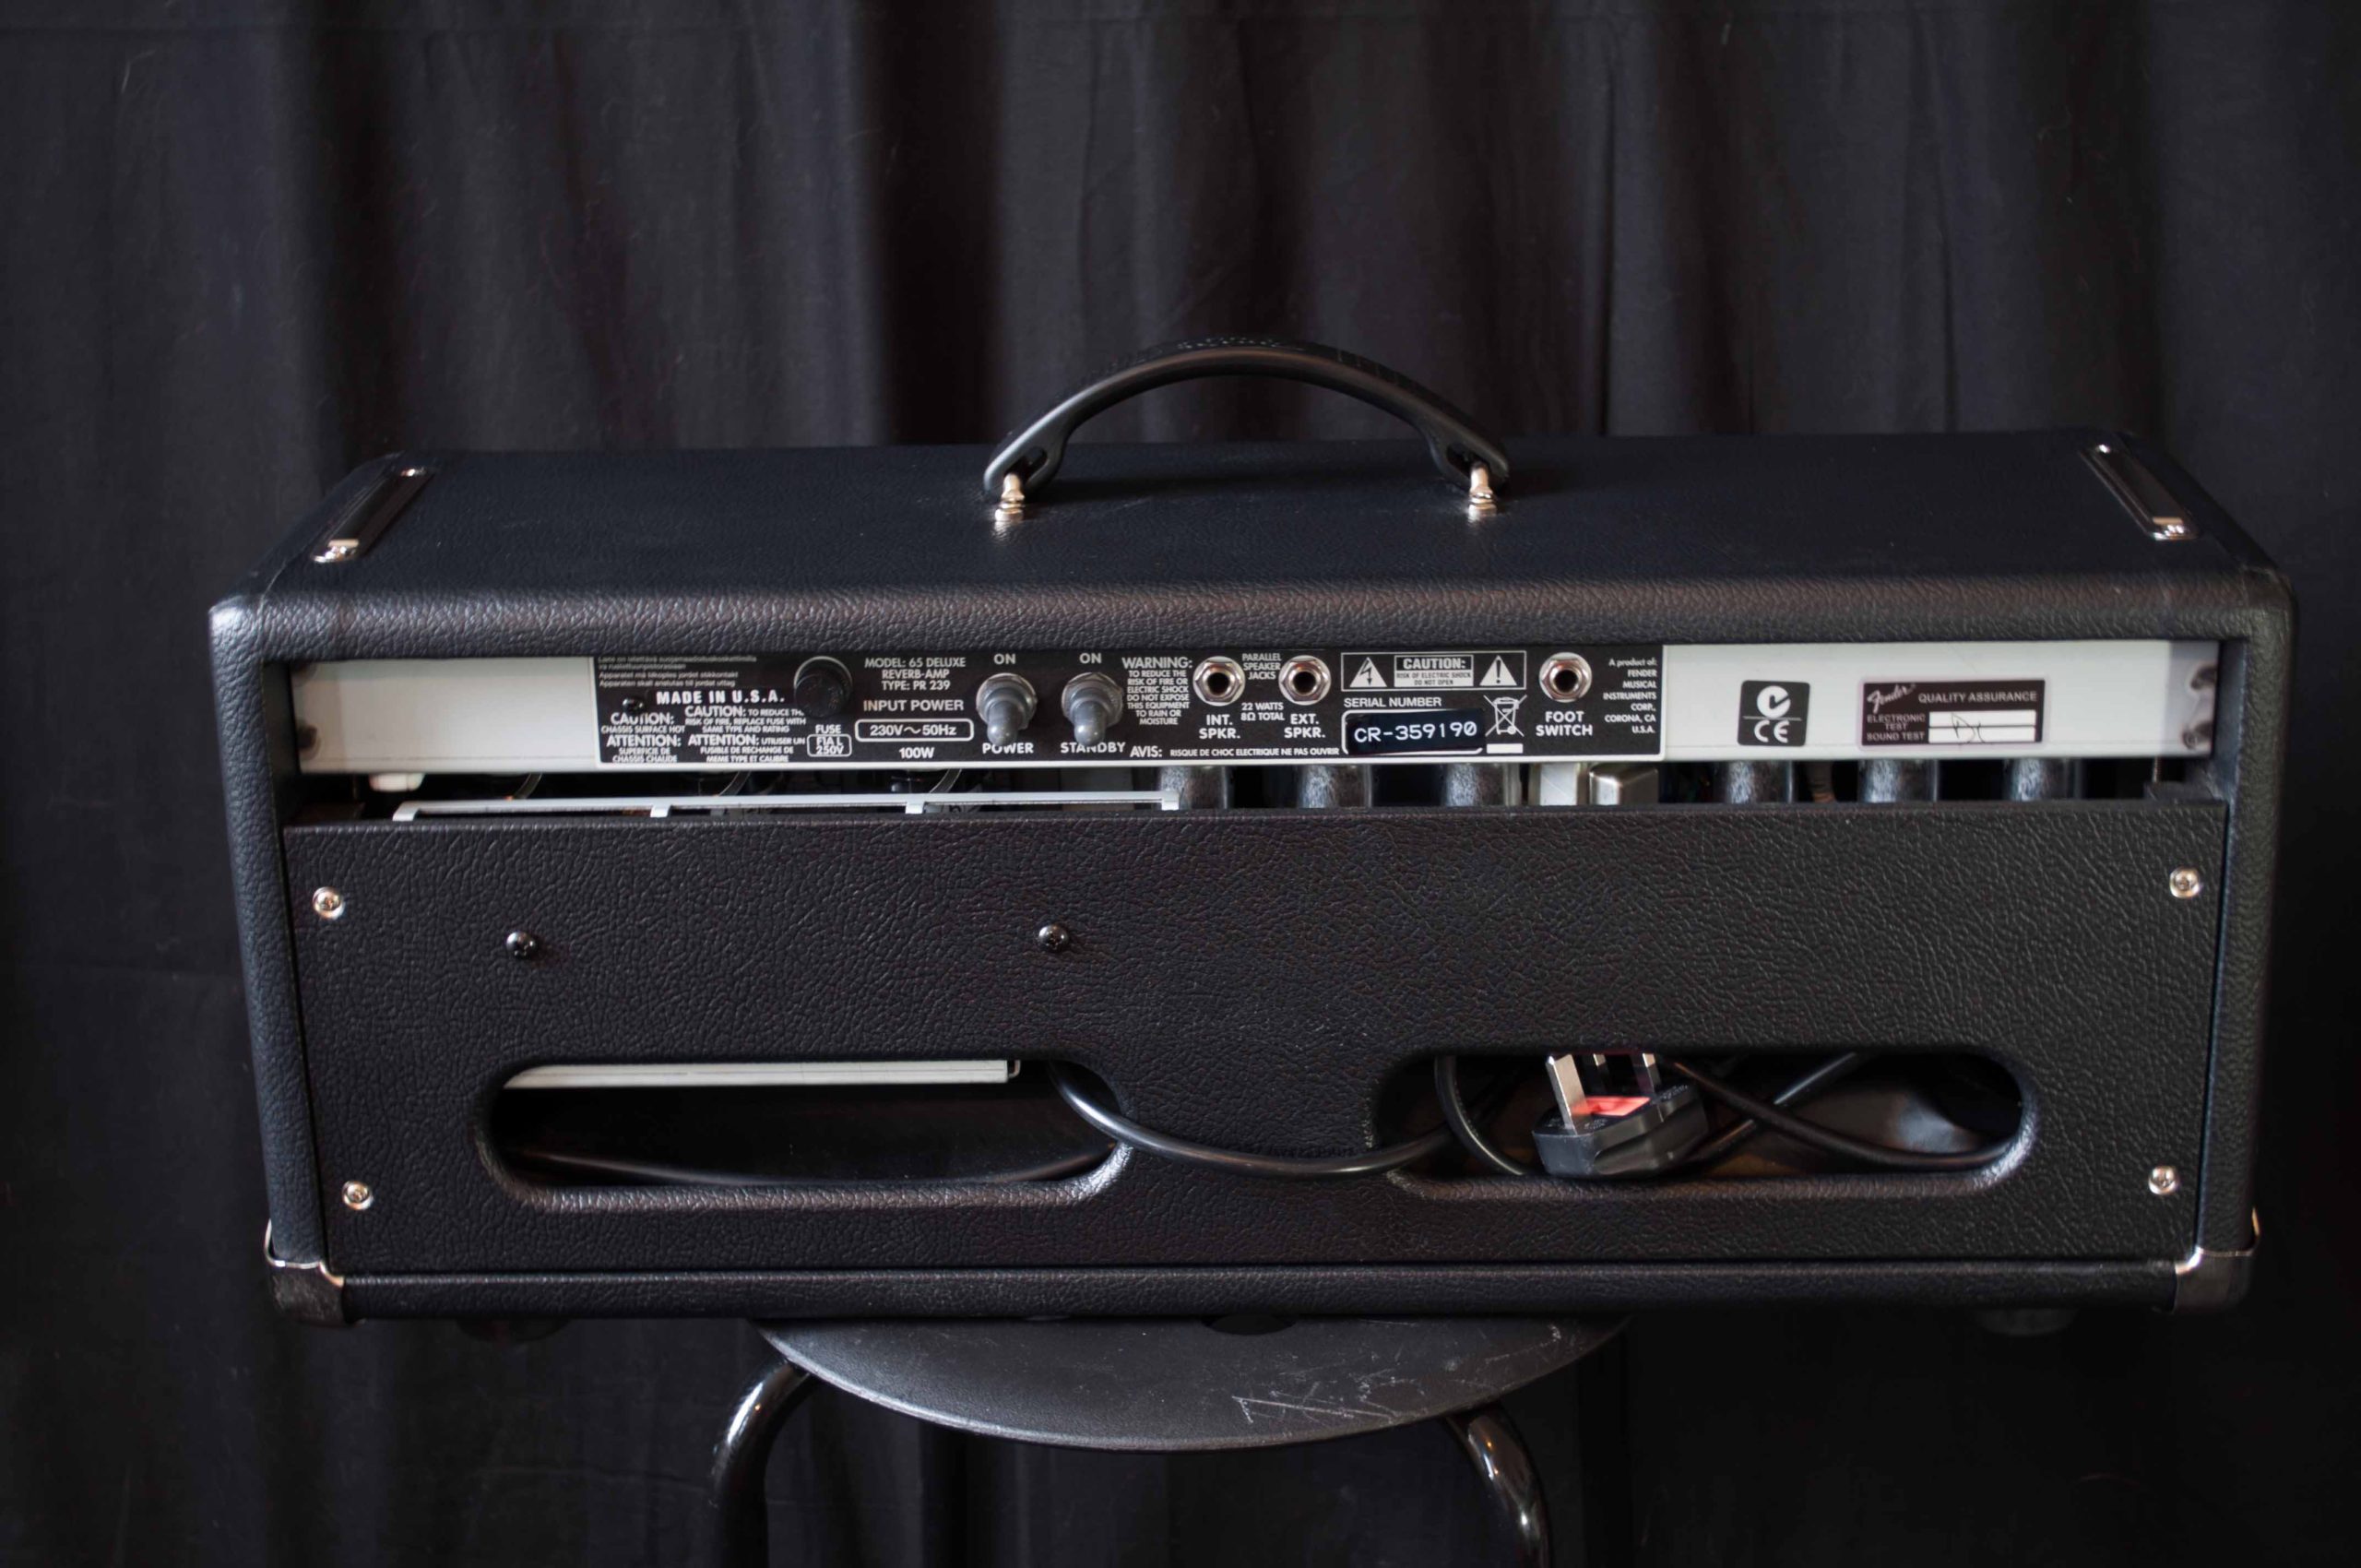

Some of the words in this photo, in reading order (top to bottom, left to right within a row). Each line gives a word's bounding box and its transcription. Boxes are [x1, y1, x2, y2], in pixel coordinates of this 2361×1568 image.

[864, 658, 906, 668] MODEL:
[908, 658, 923, 667] 65
[926, 657, 966, 667] DELUXE
[993, 654, 1015, 665] ON
[1079, 653, 1102, 664] ON
[1241, 653, 1282, 661] PARALLEL
[1121, 657, 1192, 669] WARNING:
[1243, 662, 1281, 671] SPEAKER
[1403, 658, 1465, 670] CAUTION:
[1608, 658, 1616, 666] A
[1617, 658, 1645, 668] product
[882, 669, 950, 680] REVERB-AMP
[1248, 671, 1276, 680] JACKS
[882, 681, 910, 691] TYPE:
[913, 681, 927, 690] PR
[930, 680, 951, 690] 239
[1127, 685, 1159, 694] ELECTRIC
[1622, 681, 1656, 689] MUSICAL
[656, 691, 703, 705] MADE
[708, 690, 726, 704] IN
[731, 690, 785, 704] U.S.A.
[1344, 697, 1386, 707] SERIAL
[1389, 696, 1442, 707] NUMBER
[1603, 692, 1656, 700] INSTRUMENTS
[1918, 693, 1966, 704] QUALITY
[1968, 691, 2037, 702] ASSURANCE
[863, 700, 907, 711] INPUT
[910, 699, 964, 711] POWER
[1145, 701, 1190, 709] EQUIPMENT
[1255, 702, 1284, 710] WATTS
[684, 706, 746, 717] CAUTION:
[1258, 712, 1285, 720] TOTAL
[1545, 711, 1584, 722] FOOT
[1206, 714, 1233, 726] INT.
[1290, 713, 1319, 725] EXT.
[1643, 714, 1656, 722] CA
[1867, 713, 1926, 724] ELECTRONIC
[600, 725, 634, 734] CHASSIS
[635, 725, 668, 733] SURFACE
[669, 725, 685, 733] HOT
[815, 724, 842, 734] FUSE
[1354, 721, 1477, 743] CR-359190
[1536, 724, 1593, 737] SWITCH
[1885, 722, 1907, 731] TEST
[1199, 728, 1240, 739] SPKR.
[1284, 727, 1325, 738] SPKR.
[1867, 731, 1900, 741] SOUND
[1902, 731, 1925, 740] TEST
[606, 734, 682, 747] ATTENTION:
[688, 734, 759, 745] ATTENTION:
[700, 746, 729, 754] FUSIBLE
[816, 745, 844, 754] 250V
[899, 747, 934, 758] 100W
[982, 742, 1034, 754] POWER
[1130, 745, 1162, 757] AVIS:
[1310, 747, 1339, 755] OUVRIR
[612, 754, 645, 763] CHASSIS
[646, 754, 677, 763] CHAUDE
